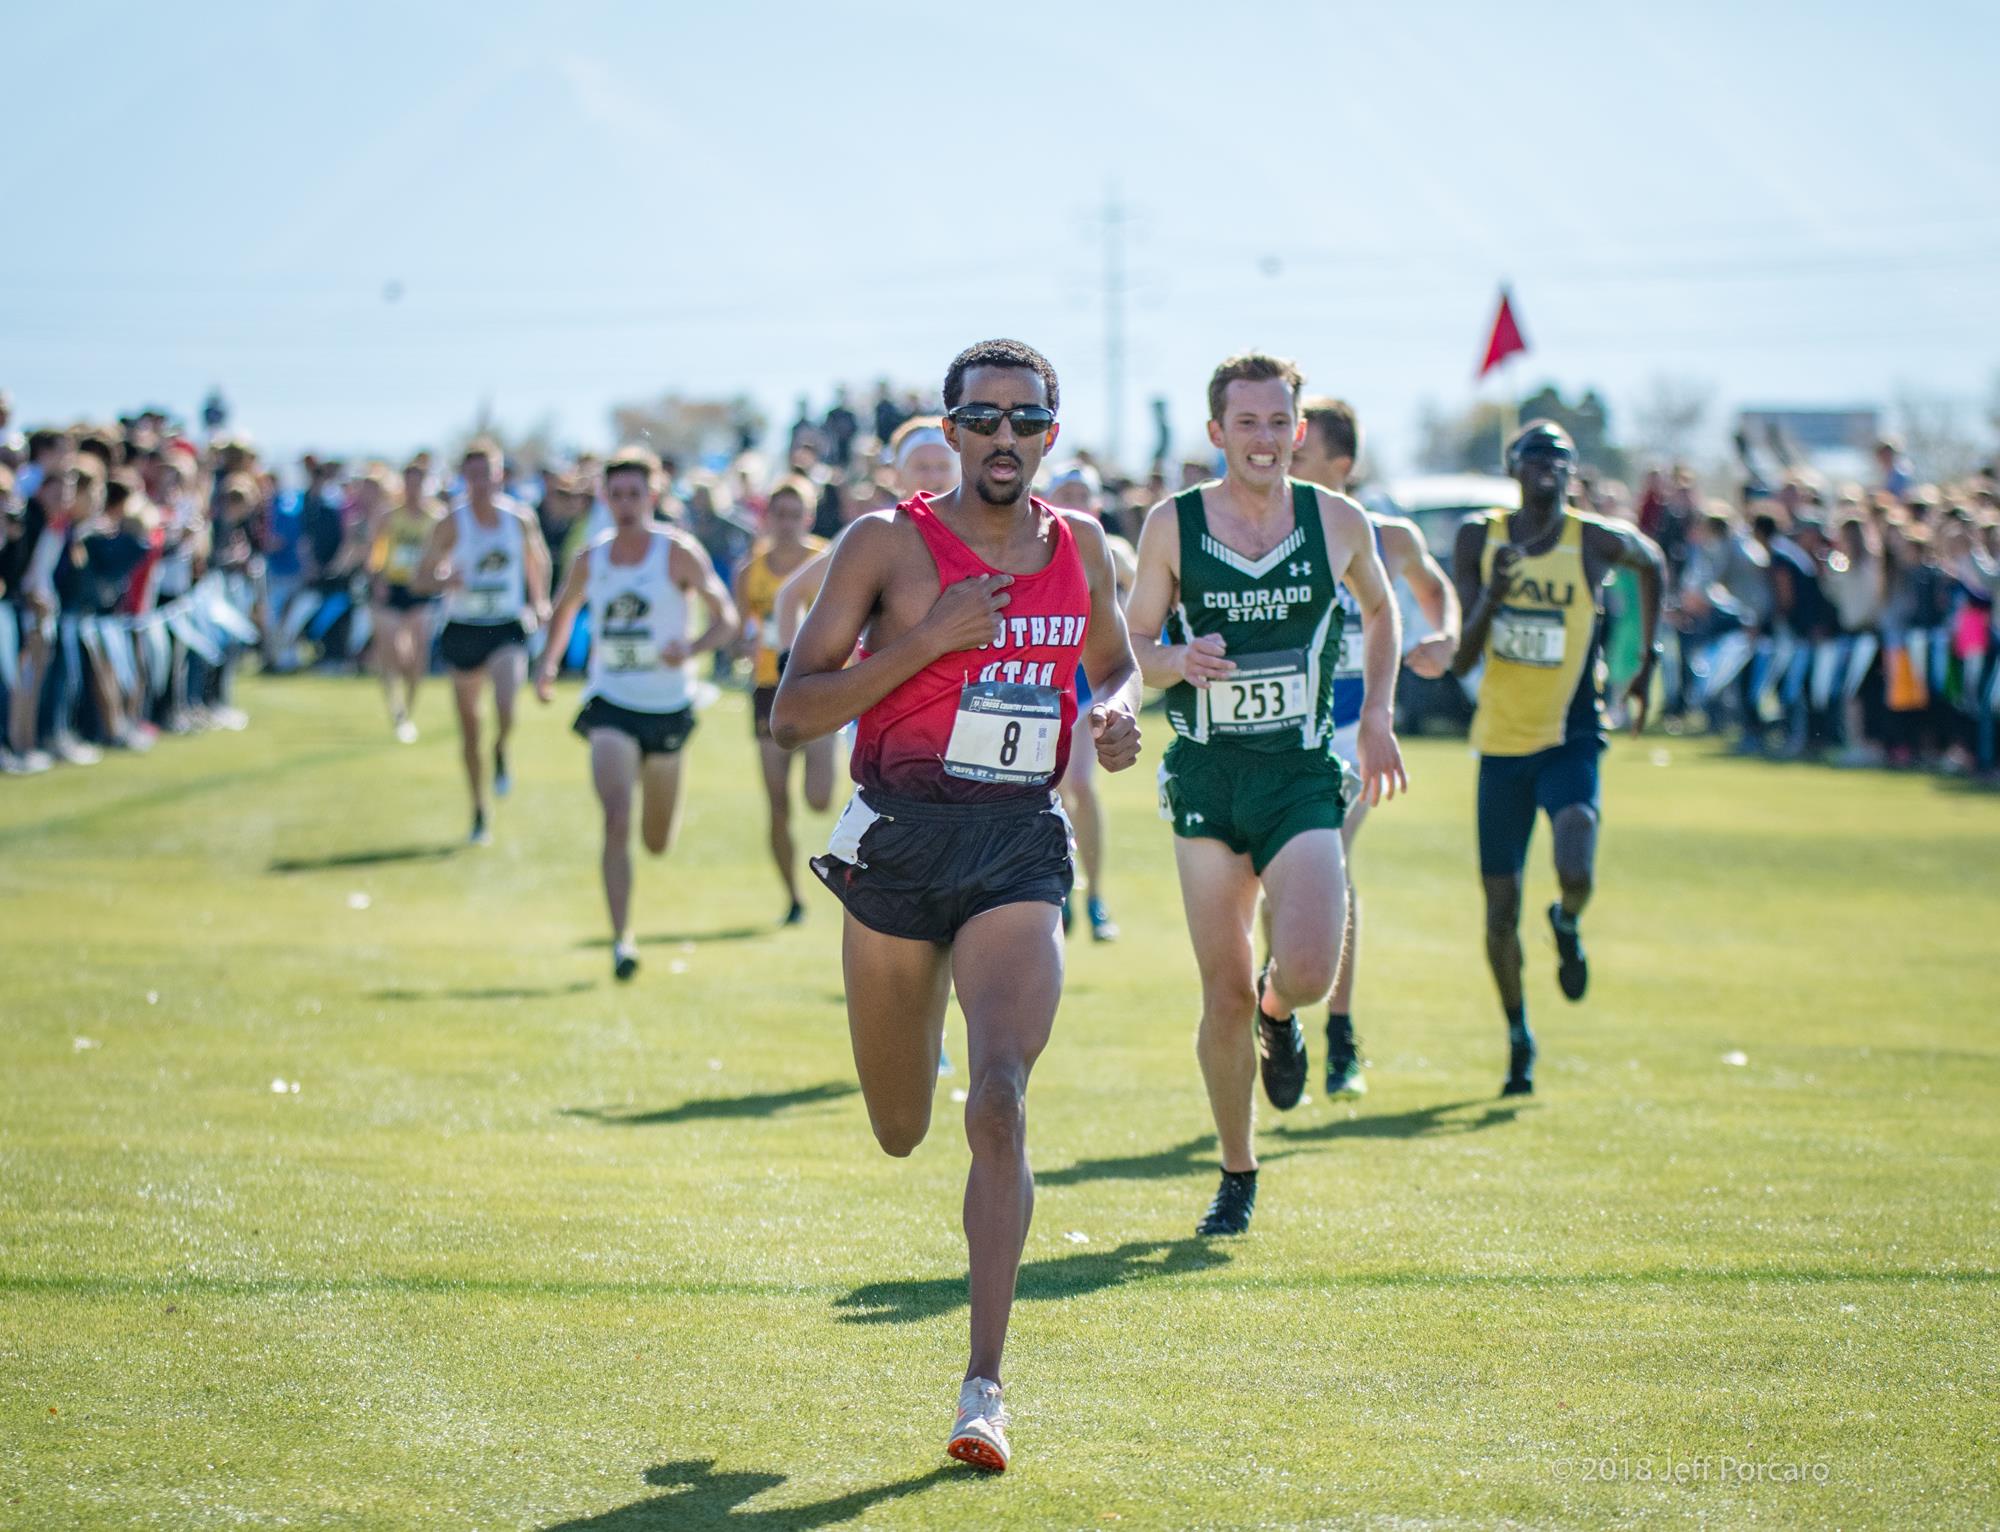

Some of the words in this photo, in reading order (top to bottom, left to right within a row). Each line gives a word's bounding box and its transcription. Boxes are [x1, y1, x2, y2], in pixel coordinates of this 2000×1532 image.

[1203, 586, 1312, 609] COLORADO
[1511, 577, 1574, 606] AU
[1227, 604, 1289, 622] STATE
[979, 661, 1056, 687] UTAH
[1231, 681, 1285, 720] 253
[1000, 720, 1021, 766] 8
